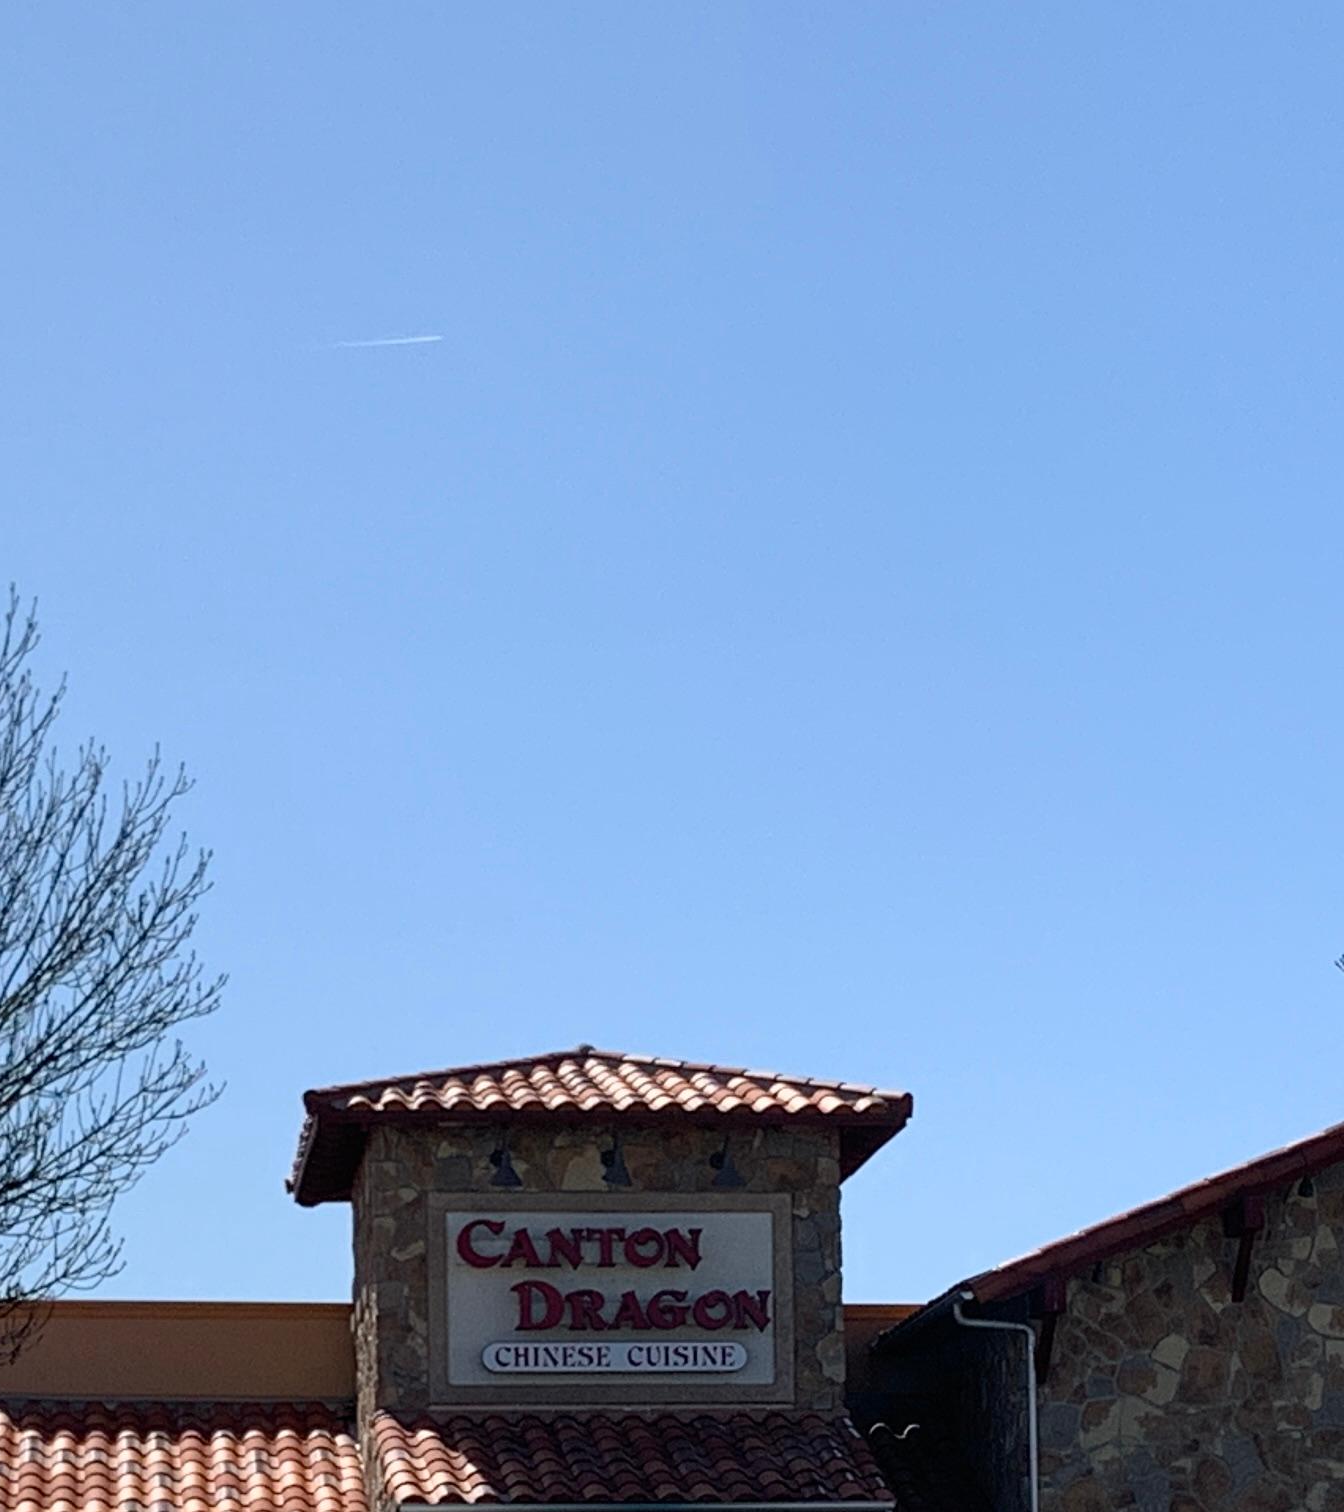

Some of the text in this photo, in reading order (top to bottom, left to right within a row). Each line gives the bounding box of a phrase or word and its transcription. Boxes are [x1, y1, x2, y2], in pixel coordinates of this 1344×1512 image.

[457, 1219, 703, 1271] CANTON
[511, 1280, 771, 1333] DRAGON
[494, 1344, 737, 1368] CHINESE CUISINE
